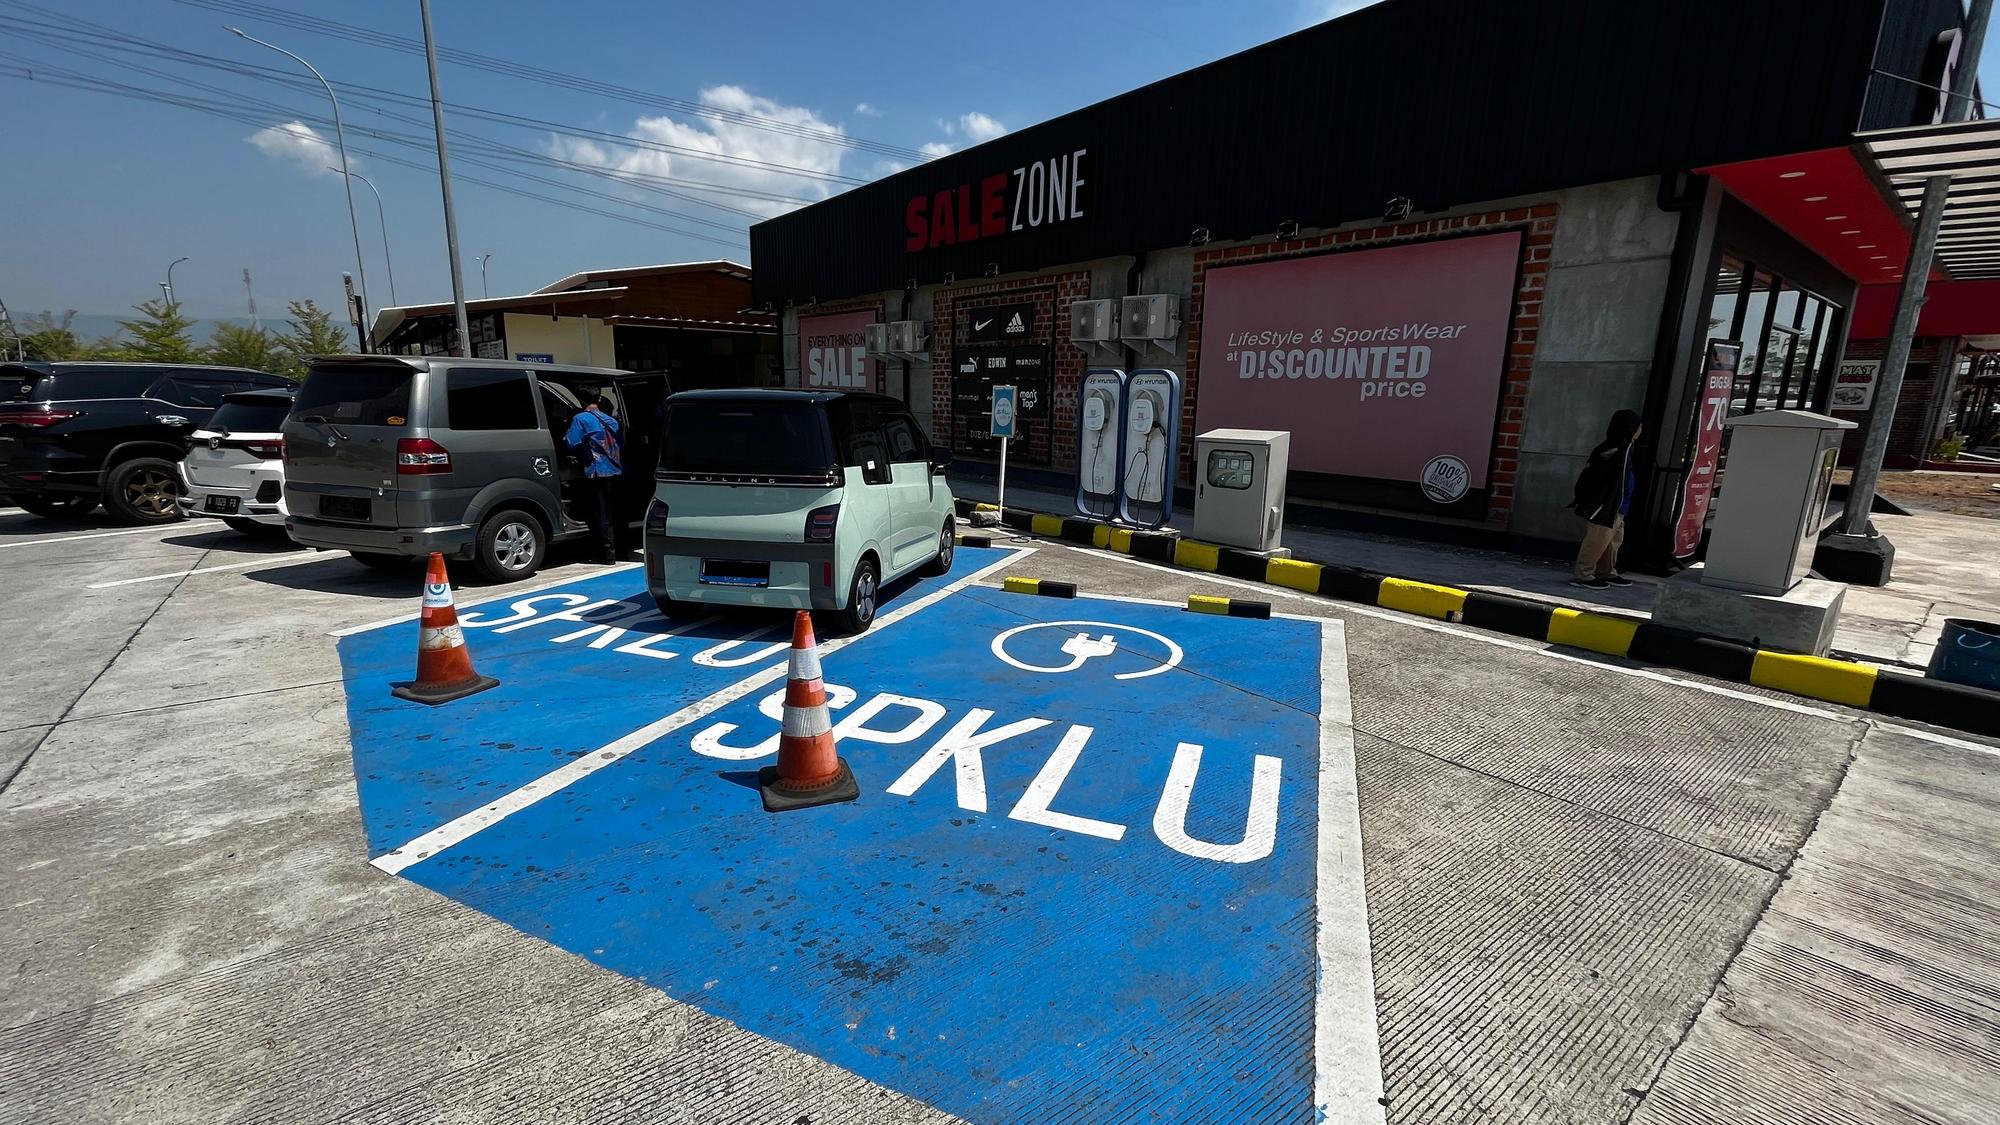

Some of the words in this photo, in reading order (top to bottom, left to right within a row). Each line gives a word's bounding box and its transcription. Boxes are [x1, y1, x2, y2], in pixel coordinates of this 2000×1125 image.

[906, 174, 1008, 252] SALE
[1012, 149, 1087, 232] ZONE
[808, 334, 852, 347] EVERYTHING
[853, 333, 866, 346] ON
[1006, 325, 1025, 333] adidas
[1228, 330, 1304, 349] LifeStyle
[1311, 329, 1324, 344] &
[1331, 323, 1467, 346] SportsWear
[809, 347, 866, 388] SALE
[988, 357, 1007, 368] EDWIN
[1226, 351, 1238, 361] at
[1239, 345, 1432, 379] D!SCOUNTED
[1360, 380, 1427, 401] price
[1022, 398, 1034, 410] Top
[690, 475, 775, 484] WULING
[1434, 460, 1465, 485] 100%
[457, 593, 824, 668] SPKLU
[690, 683, 1283, 864] SPKLU
